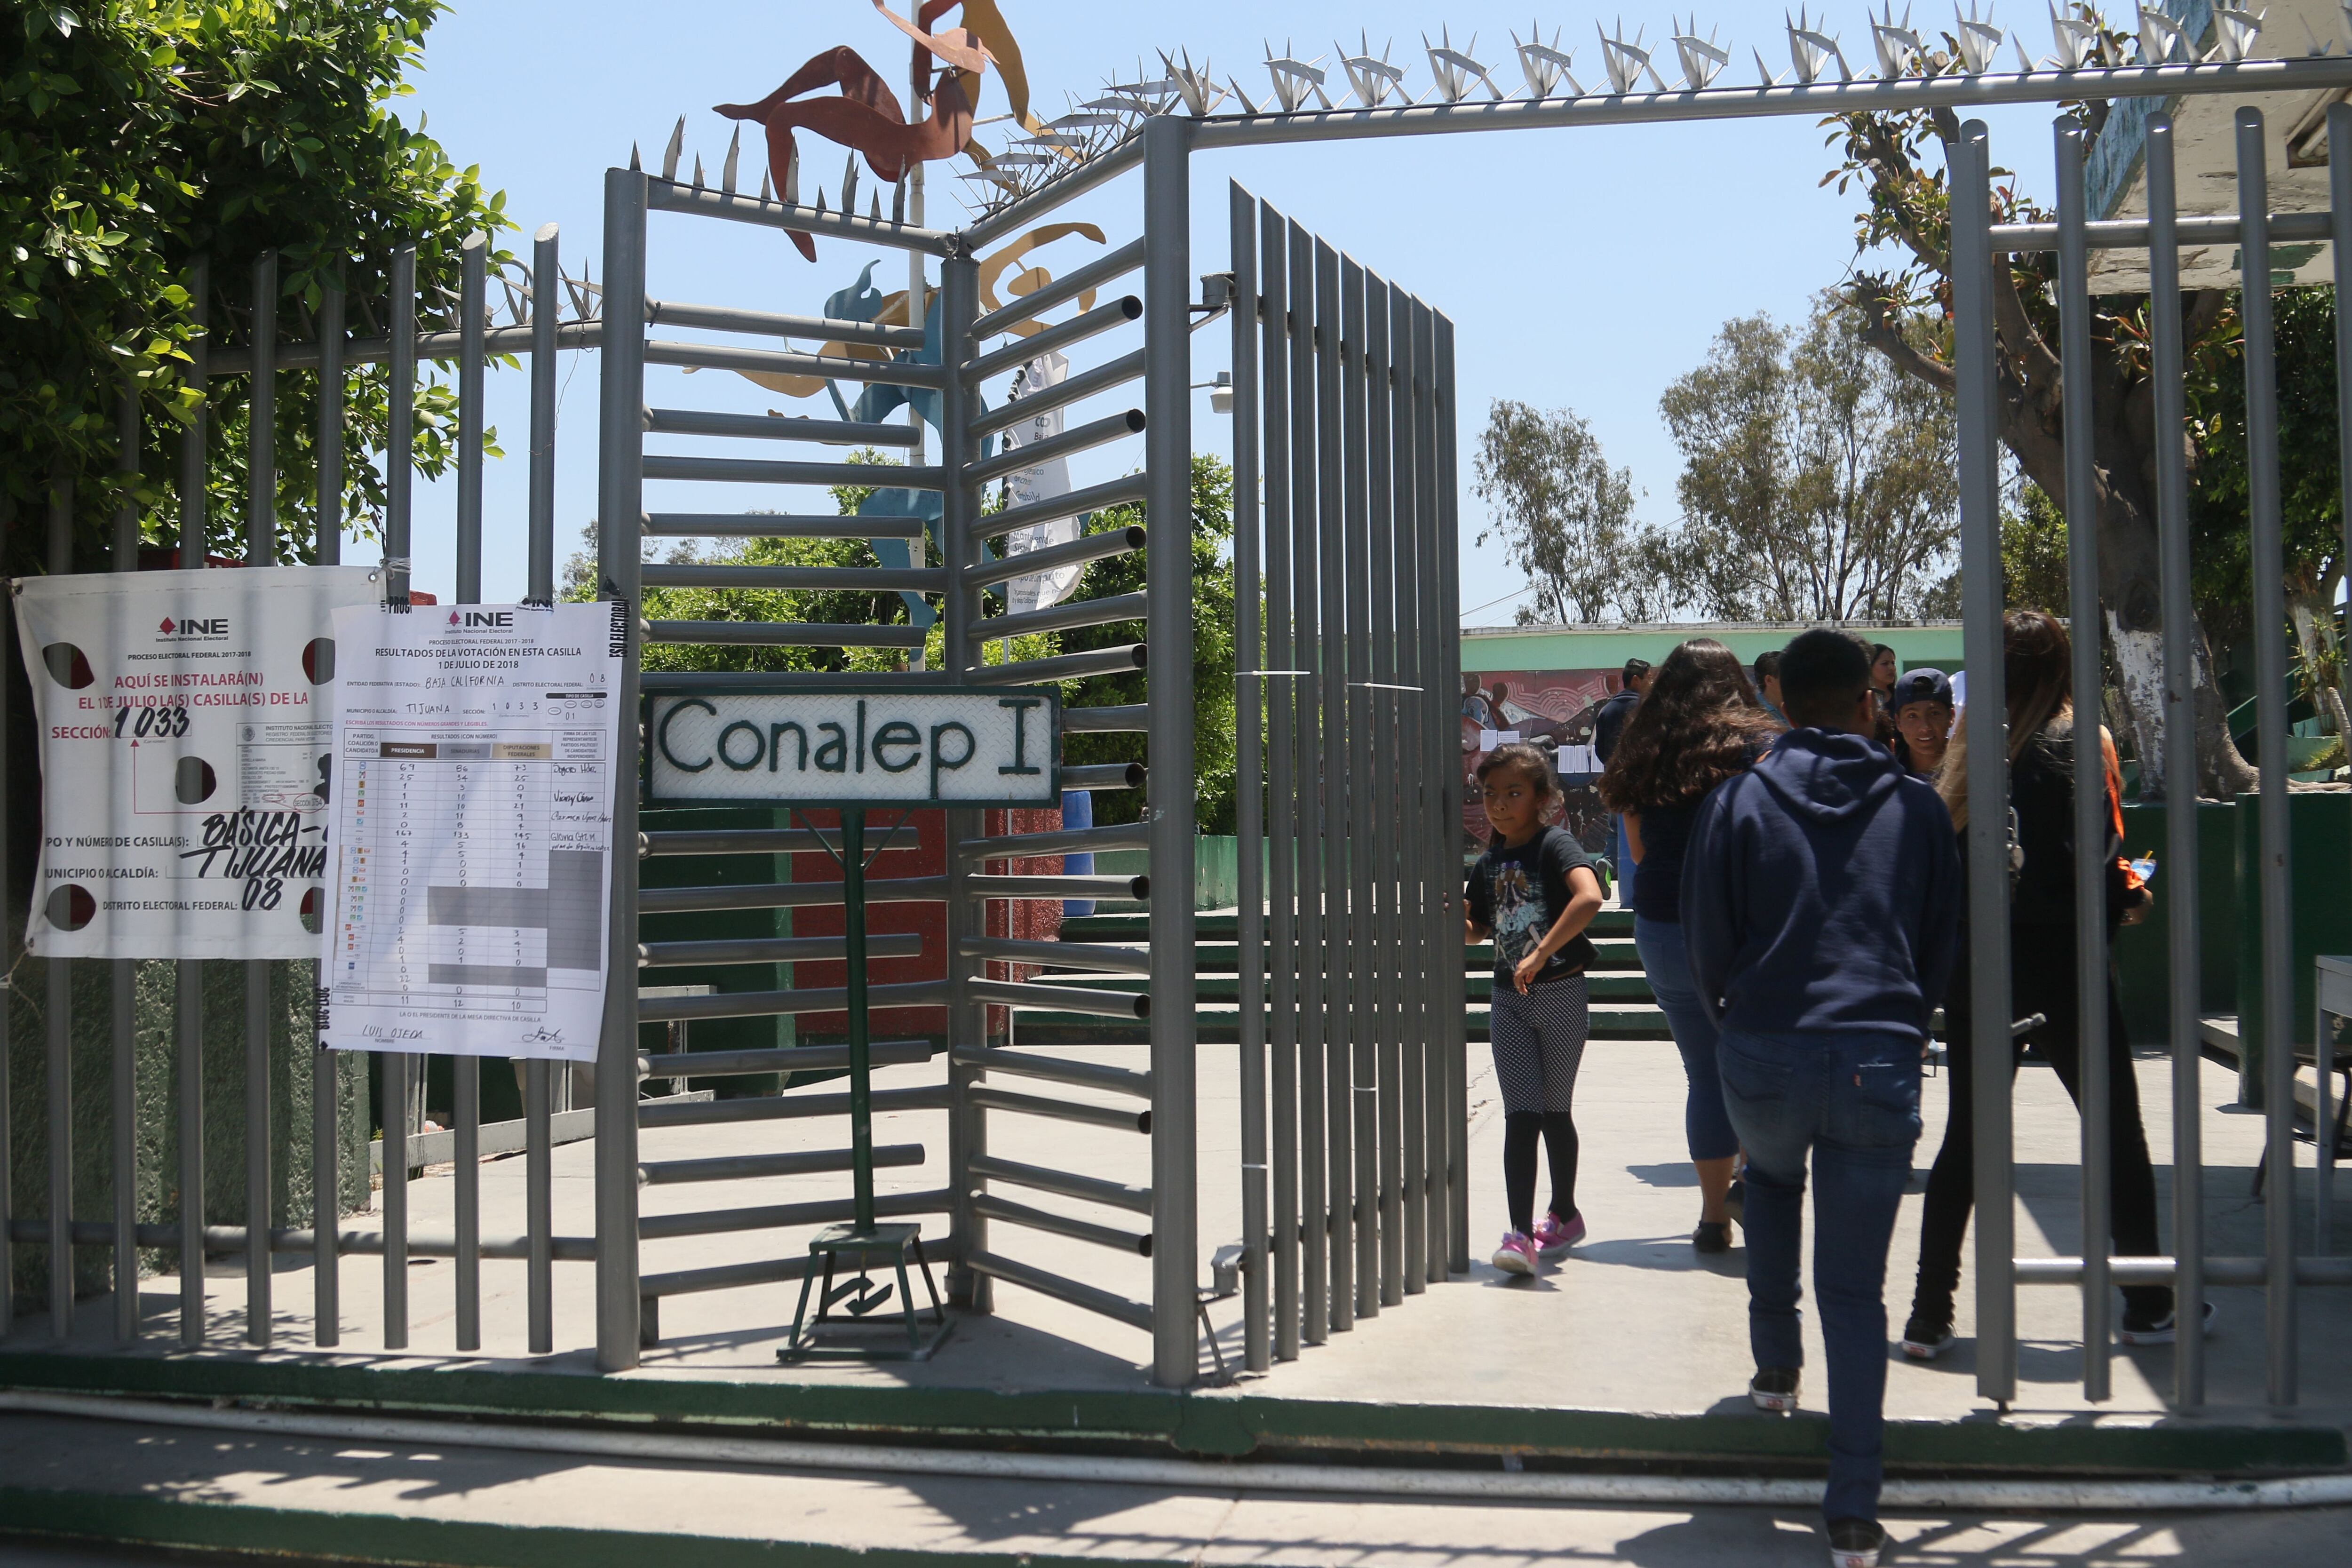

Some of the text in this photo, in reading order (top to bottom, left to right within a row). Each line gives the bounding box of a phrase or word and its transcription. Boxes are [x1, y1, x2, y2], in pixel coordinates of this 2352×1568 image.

[180, 619, 228, 634] INE
[465, 612, 513, 627] INE
[375, 648, 433, 657] RESULTADOS
[458, 647, 506, 656] VOTACIÓN
[547, 647, 581, 656] CASILLA
[454, 661, 480, 669] JULIO
[115, 671, 263, 689] AQUÍ SE INSTALARÁ(N)
[425, 675, 504, 689] BAJA CALIFORNIA
[79, 692, 308, 709] EL 1 DE JULIO LA(S) CASILLA(S) DE LA
[406, 703, 449, 714] TIJUANA
[52, 706, 190, 739] SECCIÓN: 1033
[660, 699, 1041, 800] Conalep I
[46, 837, 62, 847] PO
[66, 837, 72, 847] Y
[77, 836, 113, 847] NÚMERO
[116, 837, 130, 846] DE
[134, 836, 189, 847] CASILLA(S):
[45, 845, 327, 878] UNICIPIO O ALCALDÍA: TIJUANA
[103, 877, 283, 910] DISTRITO ELECTORAL FEDERAL: 08
[362, 1024, 383, 1037] LUIS
